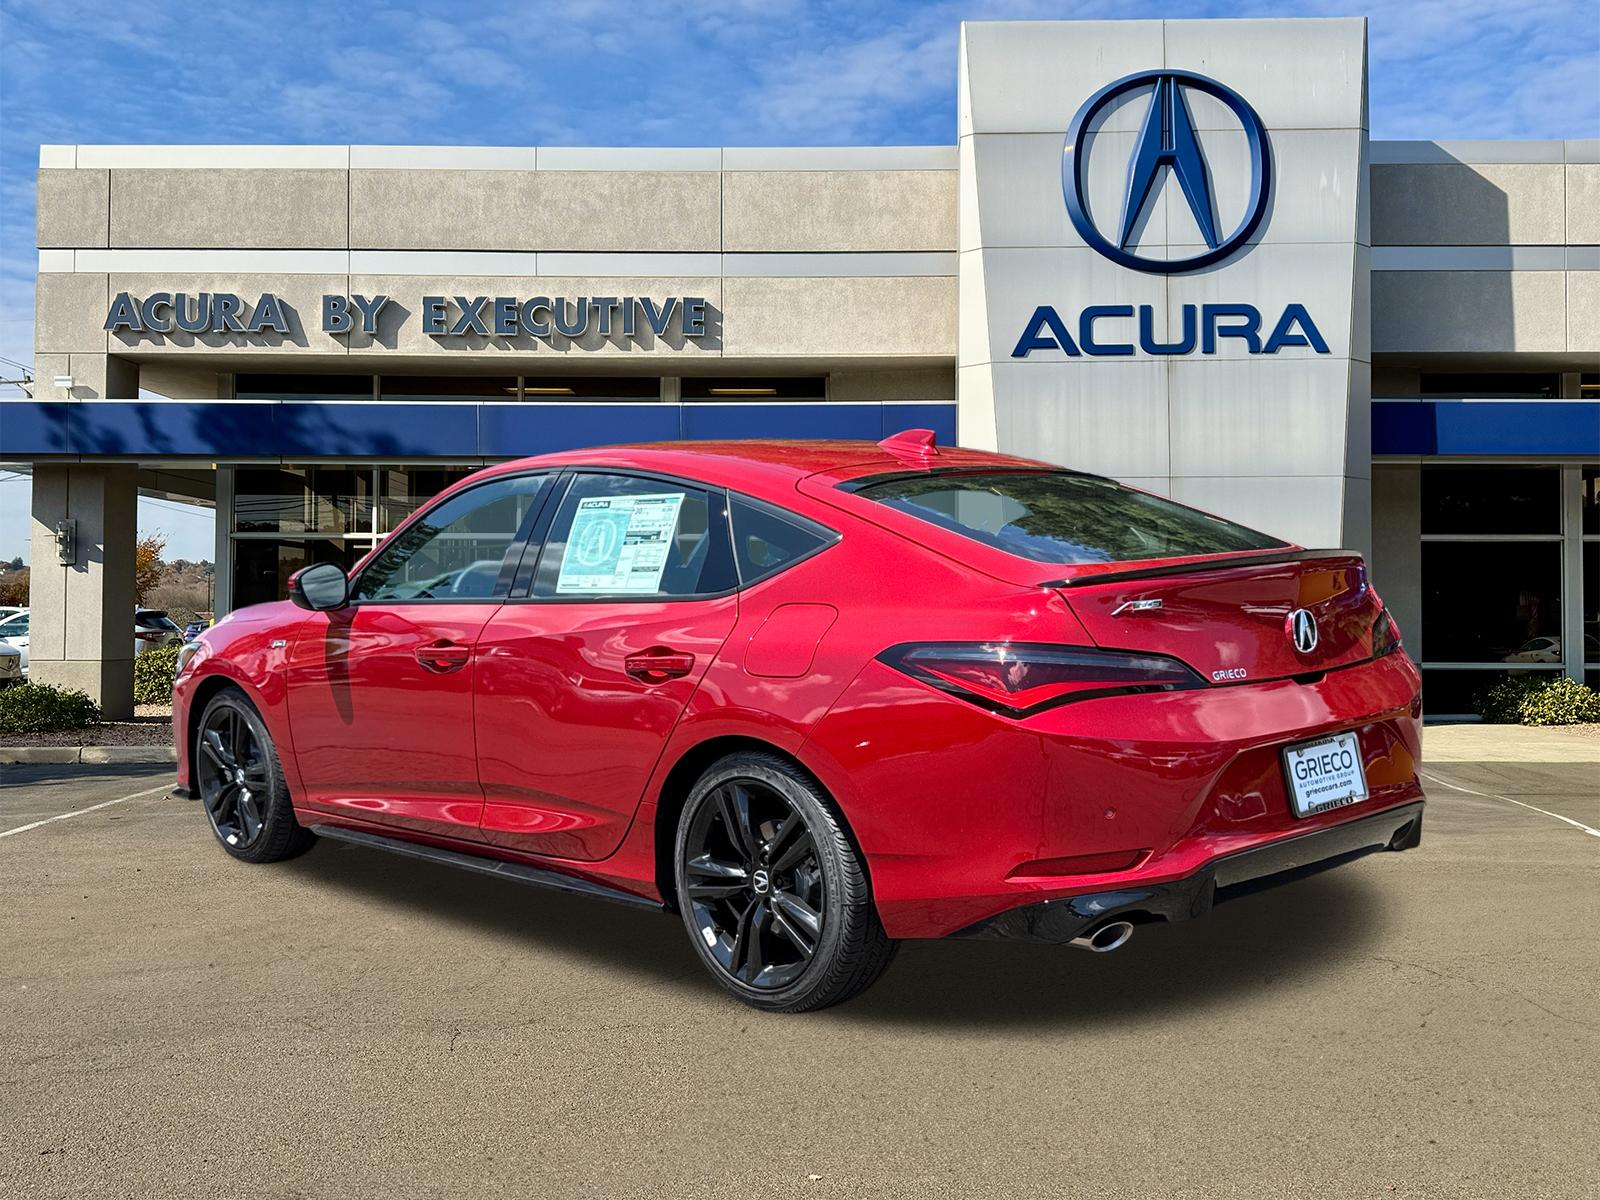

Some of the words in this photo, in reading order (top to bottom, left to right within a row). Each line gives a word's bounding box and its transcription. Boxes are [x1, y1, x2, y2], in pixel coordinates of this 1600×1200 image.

[103, 291, 291, 333] ACURA
[322, 294, 391, 334] BY
[422, 295, 706, 337] EXECUTIVE
[1010, 303, 1332, 358] ACURA
[1211, 667, 1247, 681] GRIECO
[1295, 749, 1353, 780] GRIECO
[1299, 774, 1336, 789] AUTOMOTIVE
[1337, 769, 1355, 779] GROUP
[1305, 779, 1353, 798] griecocars.com
[1315, 795, 1354, 812] GRIECO
